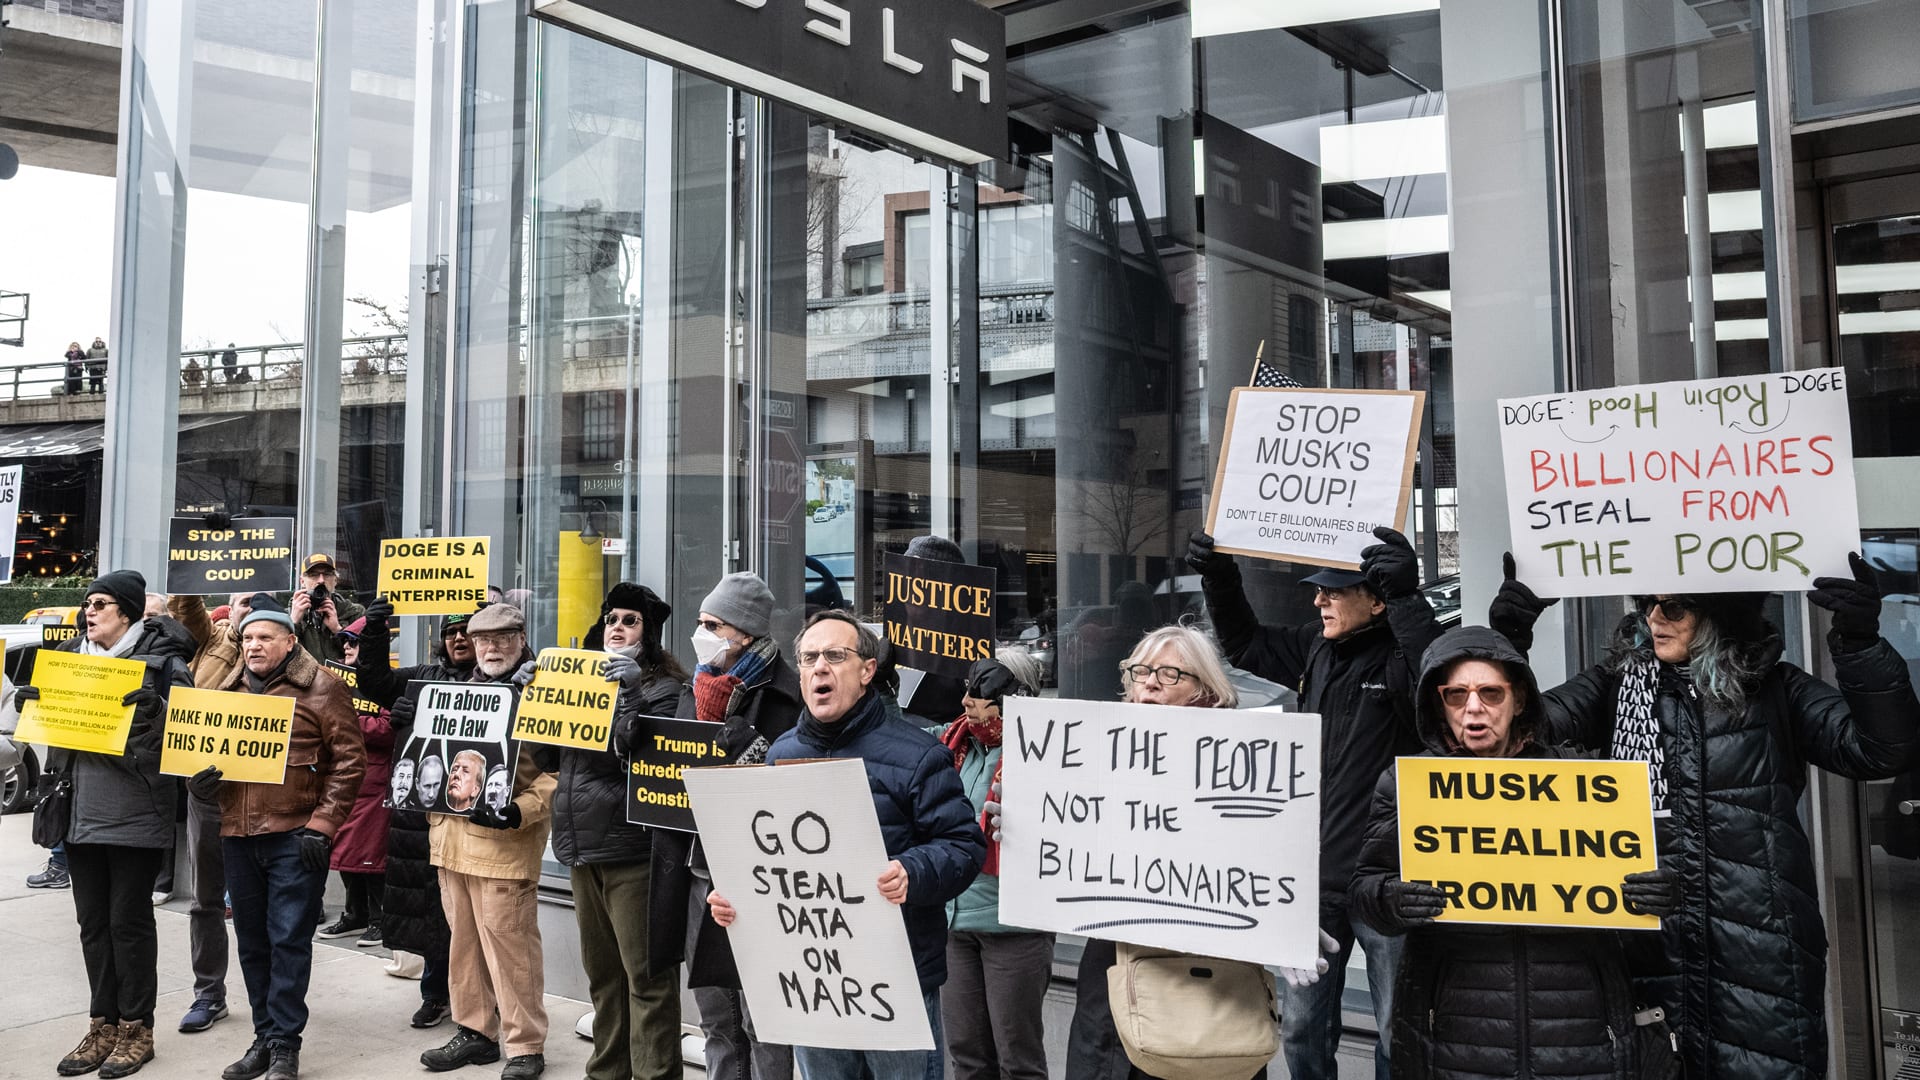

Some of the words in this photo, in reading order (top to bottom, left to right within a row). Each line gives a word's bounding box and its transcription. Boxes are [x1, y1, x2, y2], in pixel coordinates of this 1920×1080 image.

[737, 0, 990, 103] SLA
[1780, 372, 1843, 394] DOGE
[1277, 404, 1361, 434] STOP
[1504, 399, 1574, 425] DOGE:
[1256, 437, 1371, 471] MUSK'S
[1530, 435, 1834, 492] BILLIONAIRES
[1258, 472, 1357, 508] COUP!
[1226, 509, 1256, 522] DON'T
[1259, 512, 1278, 524] LET
[1280, 515, 1354, 532] BILLIONAIRES
[1527, 498, 1651, 529] STEAL
[1682, 485, 1790, 521] FROM
[188, 530, 236, 542] STOP
[240, 528, 275, 541] THE
[1258, 526, 1281, 540] OUR
[1284, 530, 1338, 545] COUNTRY
[170, 547, 291, 561] MUSK-TRUMP
[384, 543, 439, 558] DOGE
[446, 542, 466, 557] IS
[472, 541, 485, 556] A
[1541, 539, 1633, 577] THE
[1675, 531, 1811, 577] POOR
[205, 568, 255, 581] COUP
[391, 567, 474, 580] CRIMINAL
[886, 572, 991, 617] JUSTICE
[887, 620, 991, 662] MATTERS
[538, 655, 586, 675] MUSK
[590, 659, 609, 677] IS
[427, 688, 450, 710] I'm
[453, 690, 501, 712] above
[525, 686, 610, 710] STEALING
[170, 708, 201, 726] MAKE
[204, 711, 223, 727] NO
[226, 713, 288, 734] MISTAKE
[431, 715, 456, 736] the
[459, 716, 489, 739] law
[516, 716, 562, 737] FROM
[569, 722, 607, 743] YOU
[167, 732, 196, 752] THIS
[200, 734, 214, 753] IS
[219, 737, 231, 755] A
[236, 739, 284, 760] COUP
[653, 735, 708, 759] Trump
[1016, 715, 1083, 769] WE
[1107, 726, 1168, 775] THE
[1195, 736, 1315, 800] PEOPLE
[631, 760, 691, 780] shredd
[636, 786, 693, 809] Consti
[1427, 771, 1561, 802] MUSK
[1575, 774, 1620, 803] IS
[1042, 791, 1106, 824] NOT
[1125, 799, 1182, 832] THE
[751, 809, 831, 856] GO
[1413, 825, 1642, 859] STEALING
[754, 865, 865, 904] STEAL
[1038, 838, 1296, 908] BILLIONAIRES
[778, 907, 853, 940] DATA
[803, 947, 842, 975] ON
[778, 972, 896, 1022] MARS
